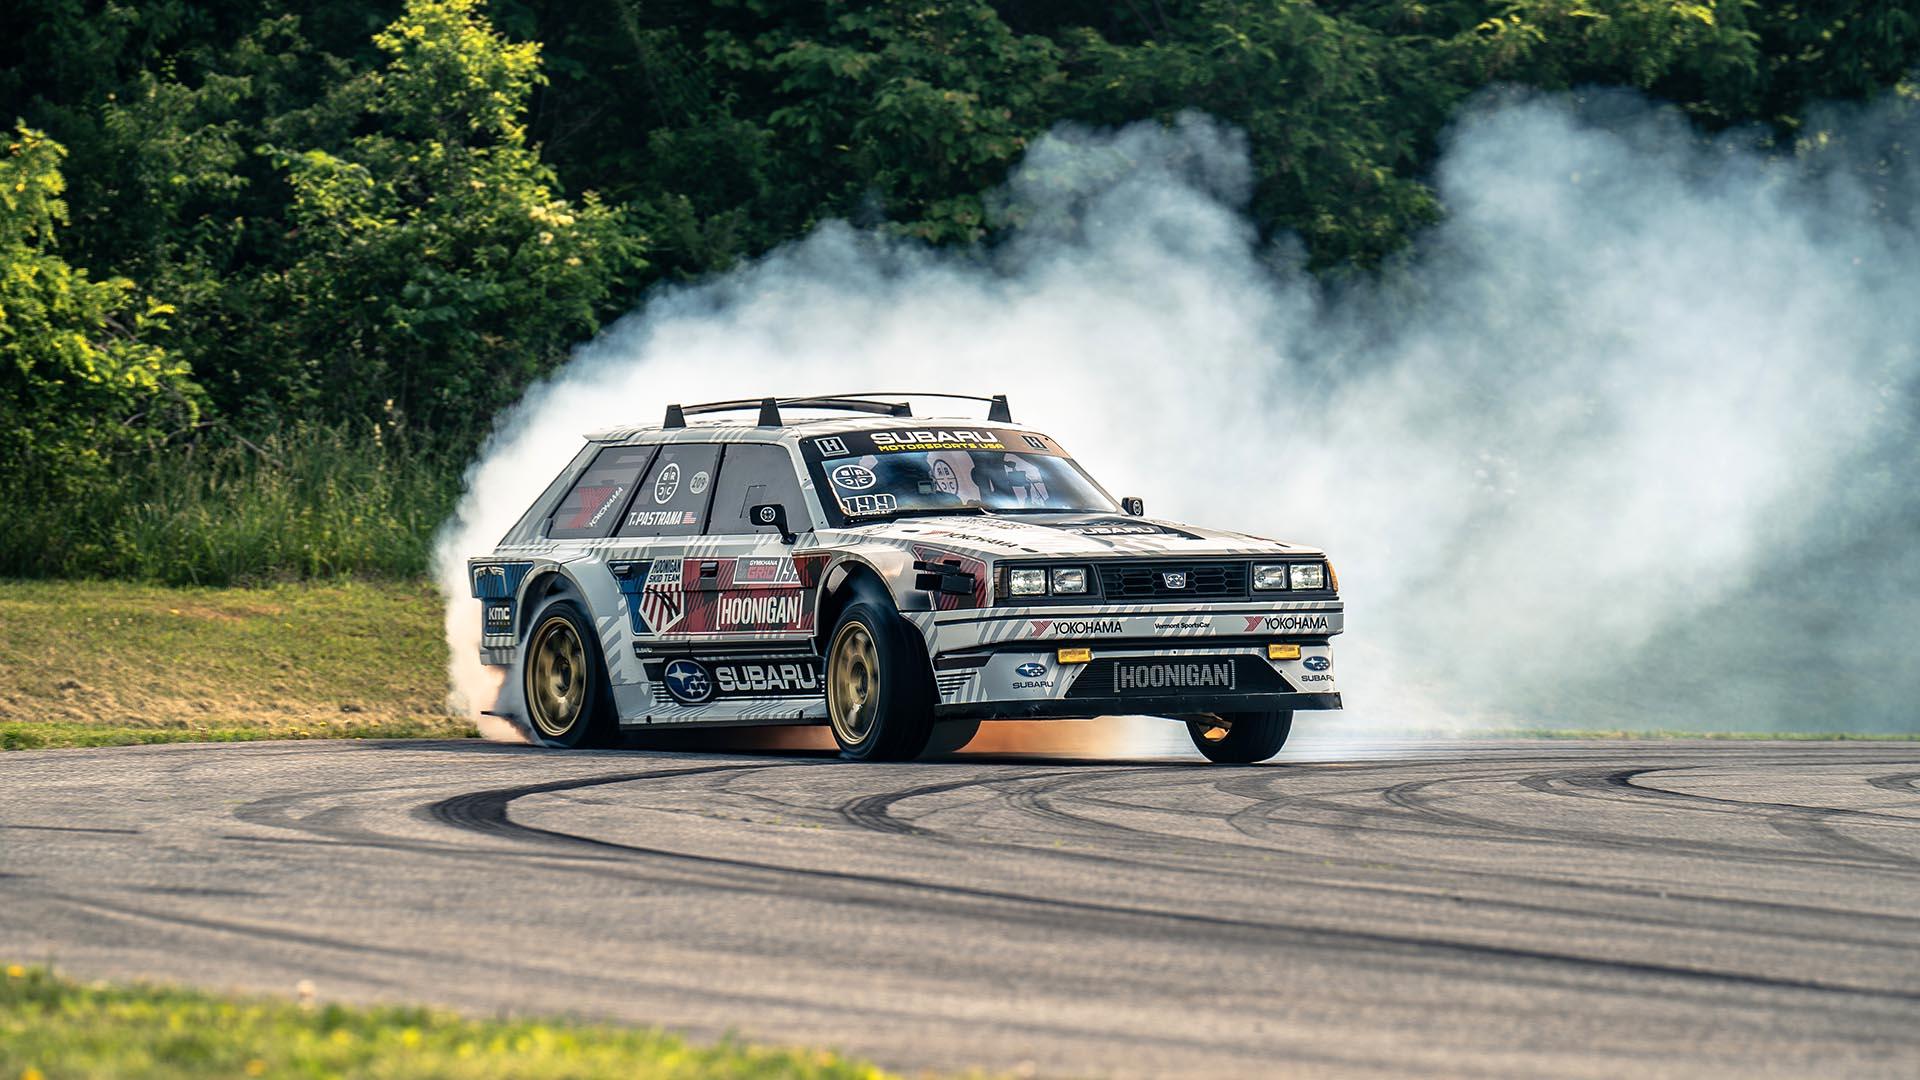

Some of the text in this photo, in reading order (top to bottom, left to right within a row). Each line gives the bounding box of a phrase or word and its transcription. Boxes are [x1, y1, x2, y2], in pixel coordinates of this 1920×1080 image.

[870, 431, 998, 445] SUBARU
[878, 442, 976, 452] MOTORSPORTS
[1053, 622, 1123, 635] YOKOHAMA
[1264, 617, 1328, 630] YOKOHAMA
[715, 664, 817, 691] SUBARU
[1012, 681, 1054, 689] SUBARU
